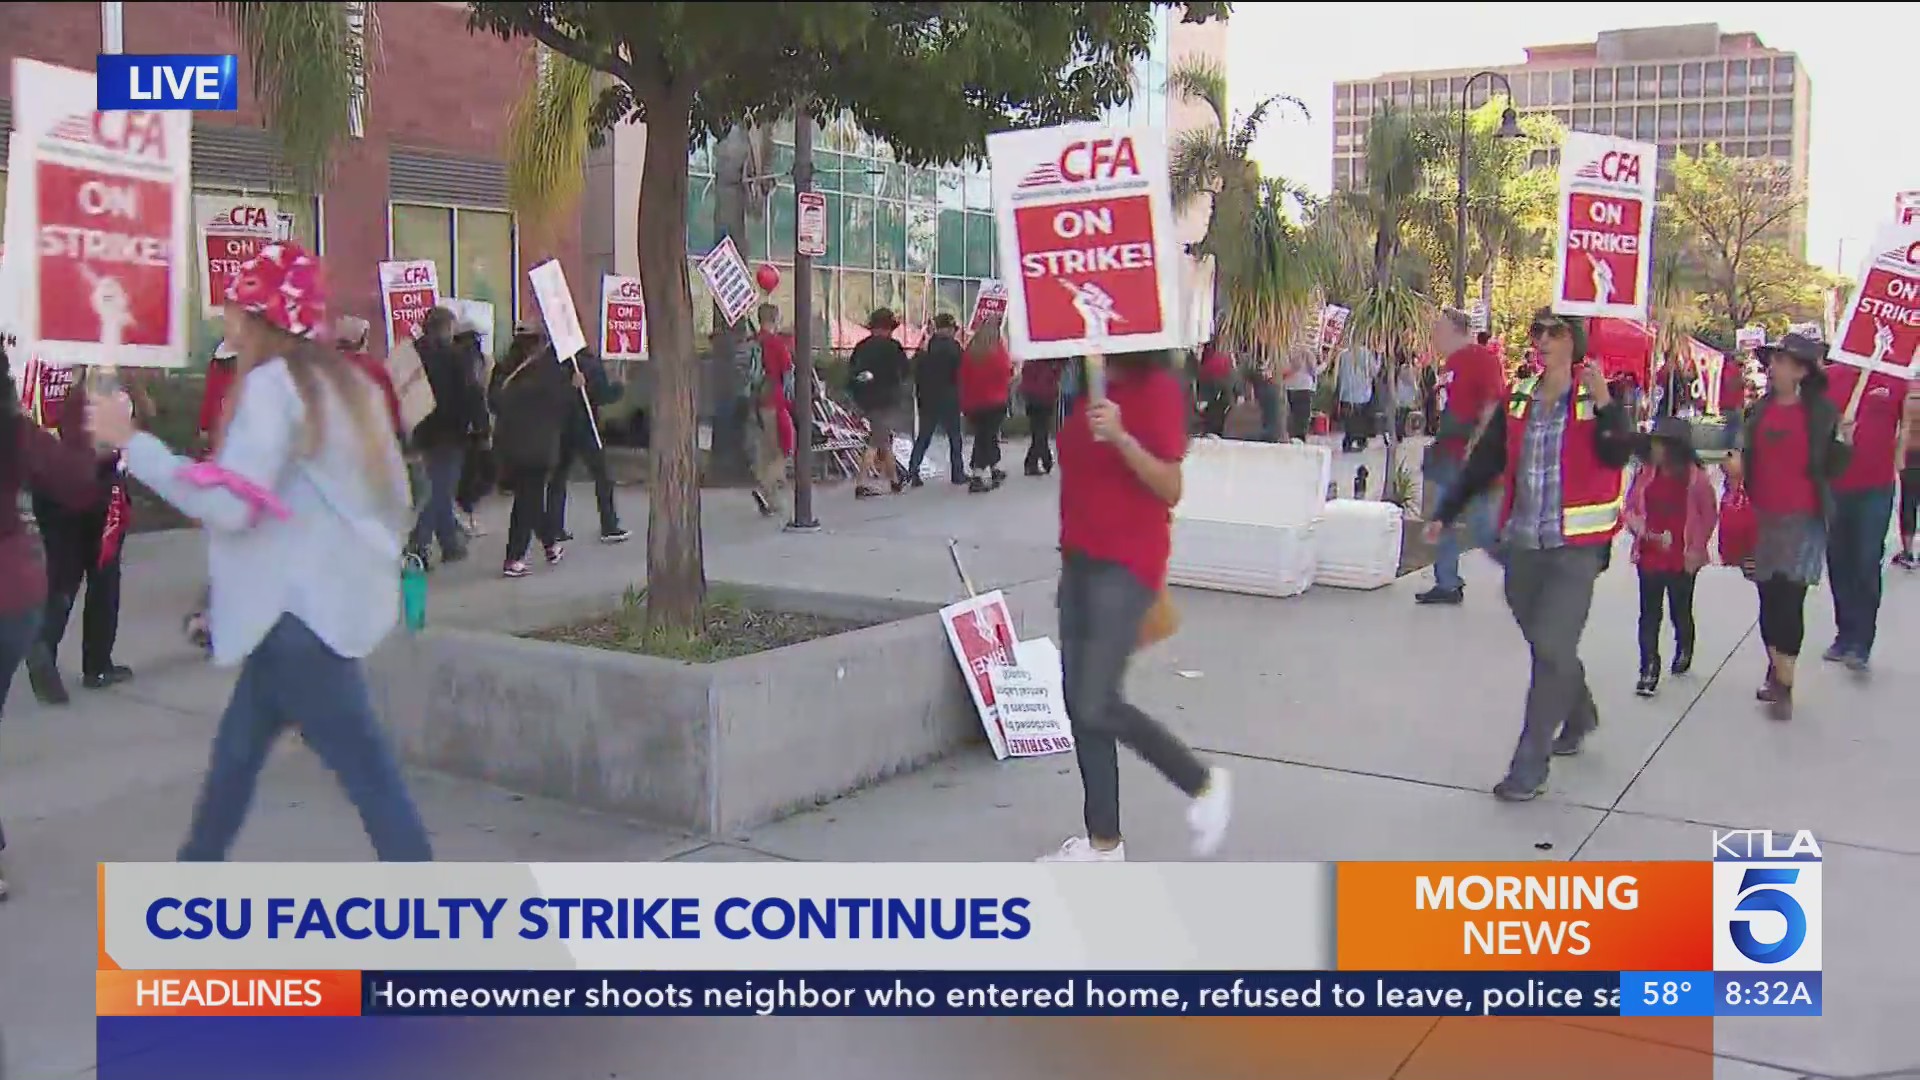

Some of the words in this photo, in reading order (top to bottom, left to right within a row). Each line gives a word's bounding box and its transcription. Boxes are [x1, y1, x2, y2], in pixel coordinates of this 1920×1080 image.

[92, 112, 167, 159] CFA
[1060, 136, 1141, 182] CFA
[1601, 151, 1641, 185] CFA
[79, 181, 137, 217] ON
[229, 207, 268, 228] CFA
[1053, 206, 1113, 239] ON
[1589, 200, 1624, 225] ON
[226, 239, 254, 257] ON
[1022, 241, 1154, 278] STRIKE!
[404, 267, 431, 284] CFA
[402, 293, 422, 305] ON
[1887, 279, 1918, 302] ON
[617, 306, 634, 319] ON
[1008, 737, 1053, 754] STRIKE!
[1052, 736, 1072, 750] ON
